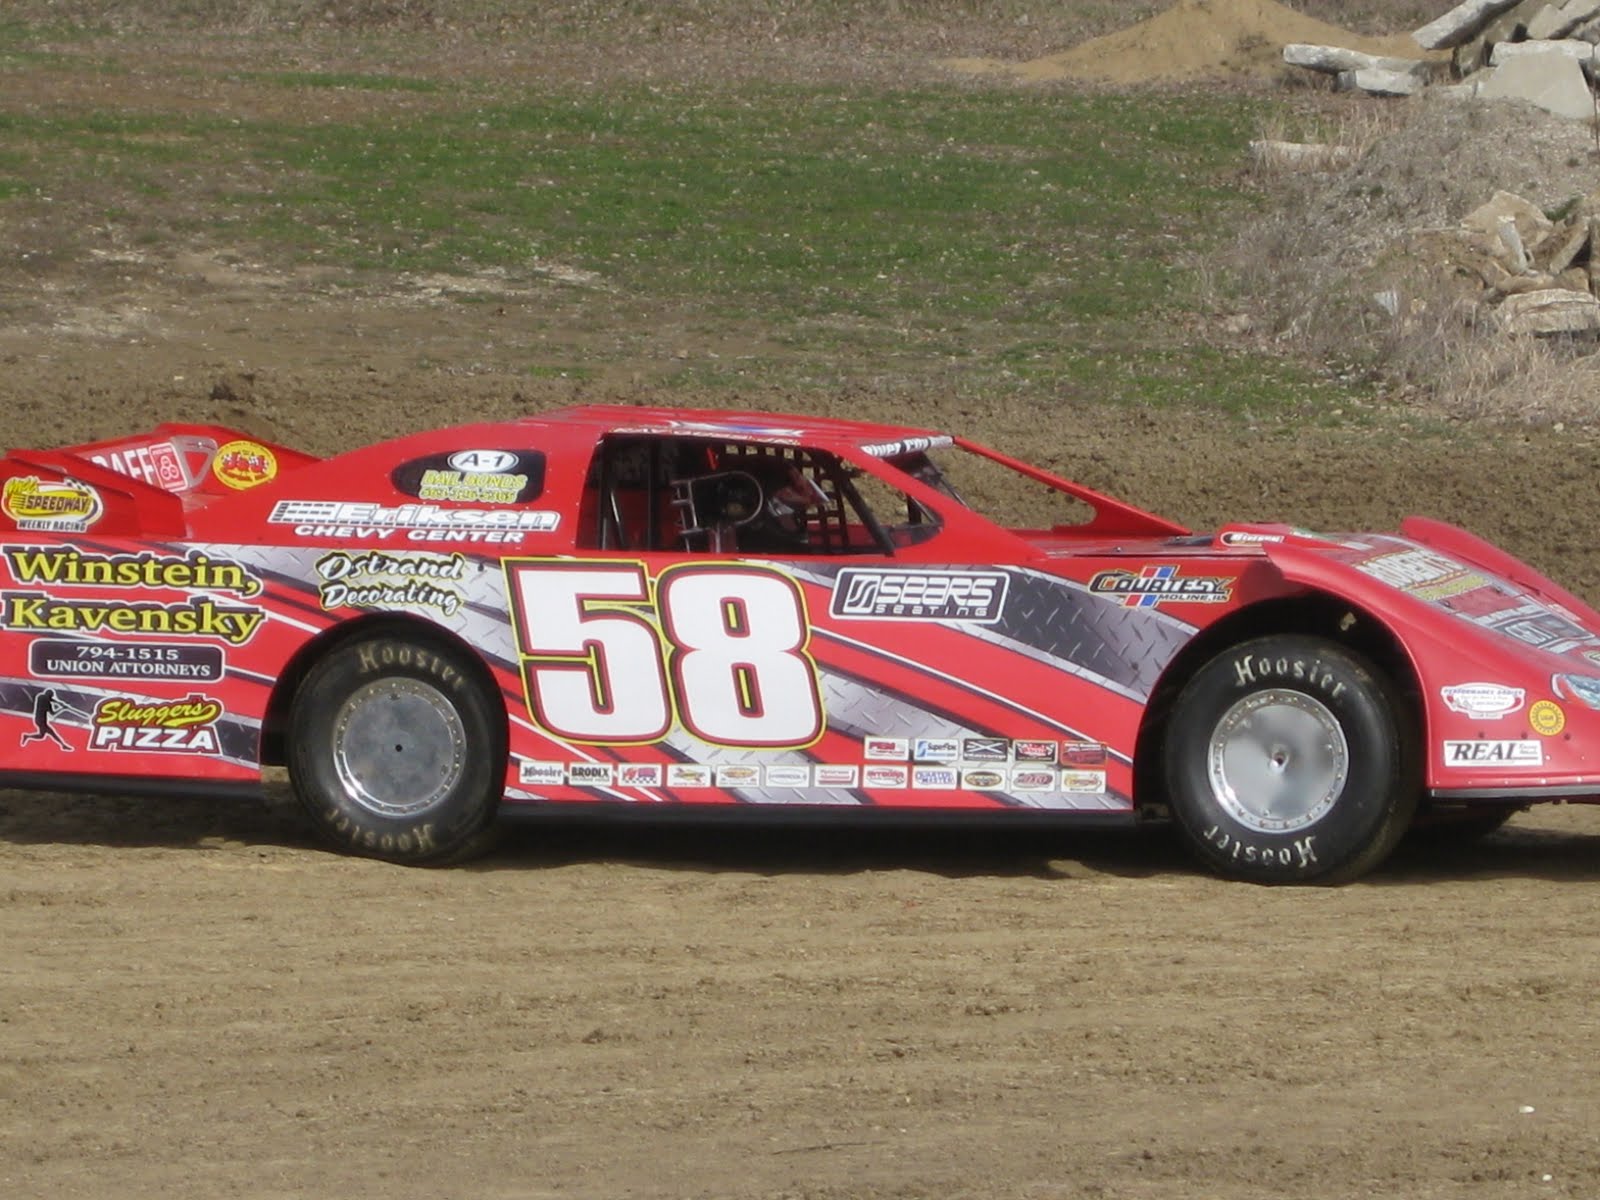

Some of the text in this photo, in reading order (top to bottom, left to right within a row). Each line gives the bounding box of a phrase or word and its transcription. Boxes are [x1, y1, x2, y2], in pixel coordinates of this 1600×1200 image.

[461, 453, 505, 467] A-1
[463, 472, 527, 490] BONDS
[26, 494, 90, 513] SPEEDWAY
[19, 519, 87, 532] WEEKLY RACING
[335, 503, 560, 530] Eriksen
[294, 524, 525, 544] CHEVY CENTER
[10, 550, 262, 596] Winstein,
[316, 550, 465, 580] Ostrand
[320, 580, 460, 615] Decorating
[876, 575, 998, 607] SEARS
[8, 596, 266, 642] Kavensky
[76, 645, 180, 661] 794-1515
[506, 561, 824, 748] 58
[46, 659, 212, 677] UNION ATTORNEYS
[1233, 654, 1348, 698] Hoosier
[95, 726, 215, 750] PIZZA
[1446, 742, 1518, 761] REAL
[522, 766, 563, 778] Hoosier
[571, 766, 609, 777] BRODIX
[1202, 824, 1319, 868] Hoosier
